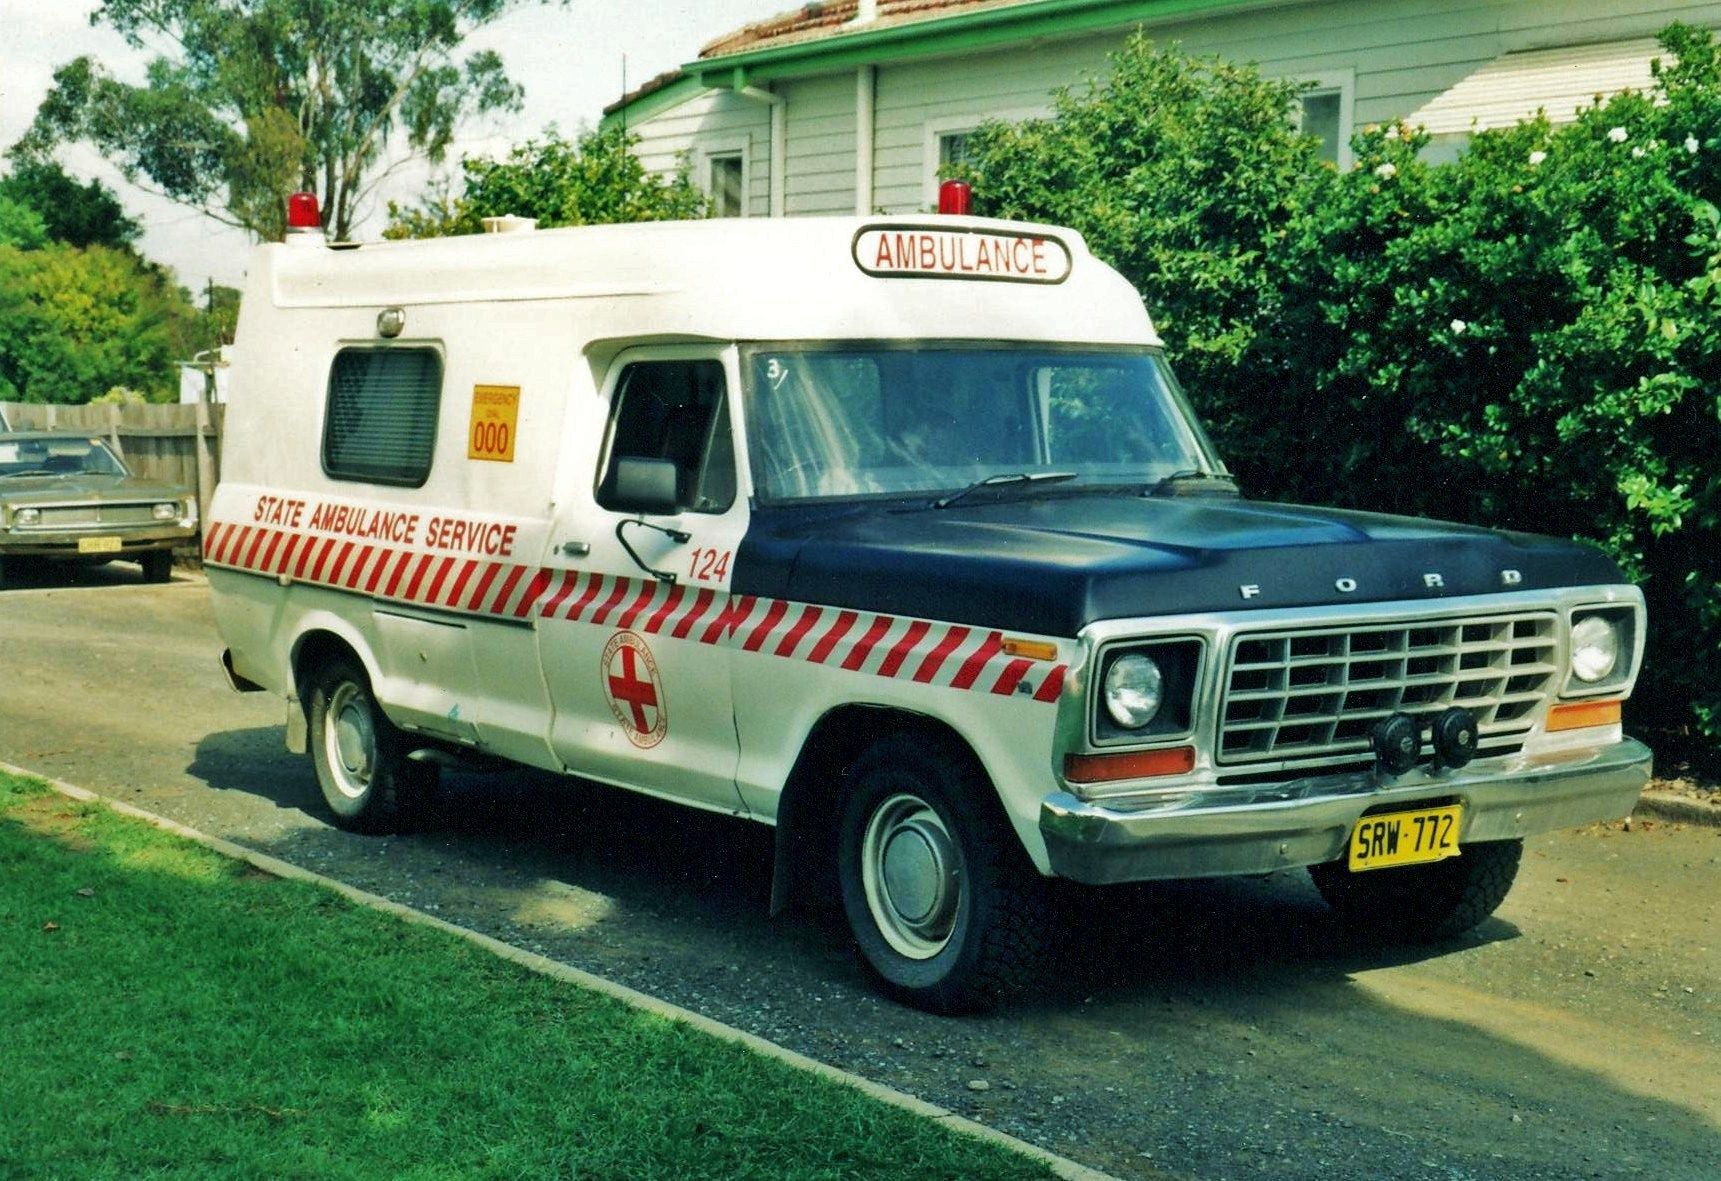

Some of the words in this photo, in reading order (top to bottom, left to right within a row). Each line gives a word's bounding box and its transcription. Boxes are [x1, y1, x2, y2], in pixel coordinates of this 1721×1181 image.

[876, 233, 1047, 274] AMBULANCE
[474, 421, 508, 454] 000
[254, 495, 305, 528] STATE
[309, 503, 419, 544] AMBULANCE
[425, 517, 517, 556] SERVICE
[689, 547, 731, 582] 124
[1239, 569, 1523, 599] FORD
